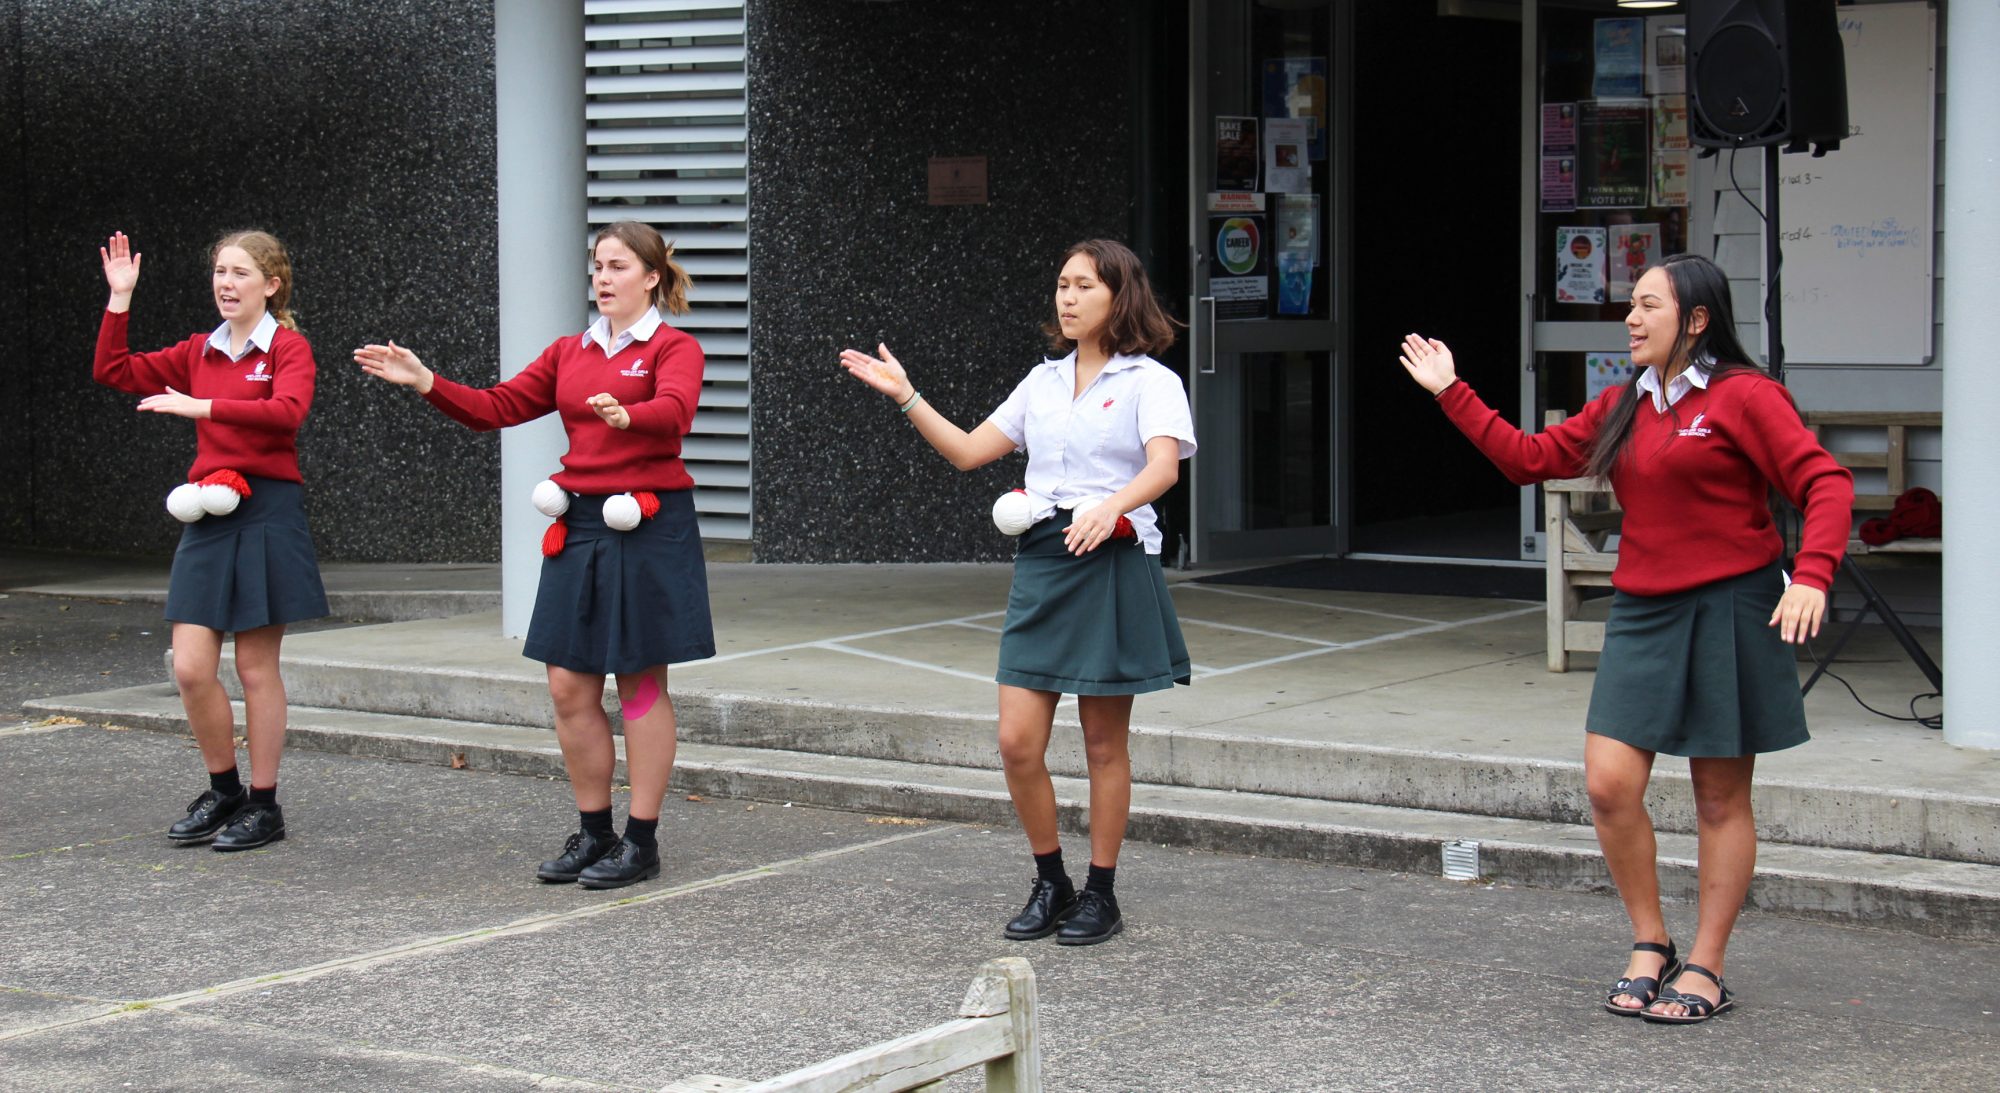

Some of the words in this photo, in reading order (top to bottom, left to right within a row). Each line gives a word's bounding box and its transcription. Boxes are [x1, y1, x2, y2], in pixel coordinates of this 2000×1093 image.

[1219, 121, 1241, 131] BAKE
[1219, 131, 1240, 141] SALE
[1590, 196, 1615, 205] VOTE
[1618, 196, 1634, 204] IVY
[1617, 234, 1652, 250] JUT
